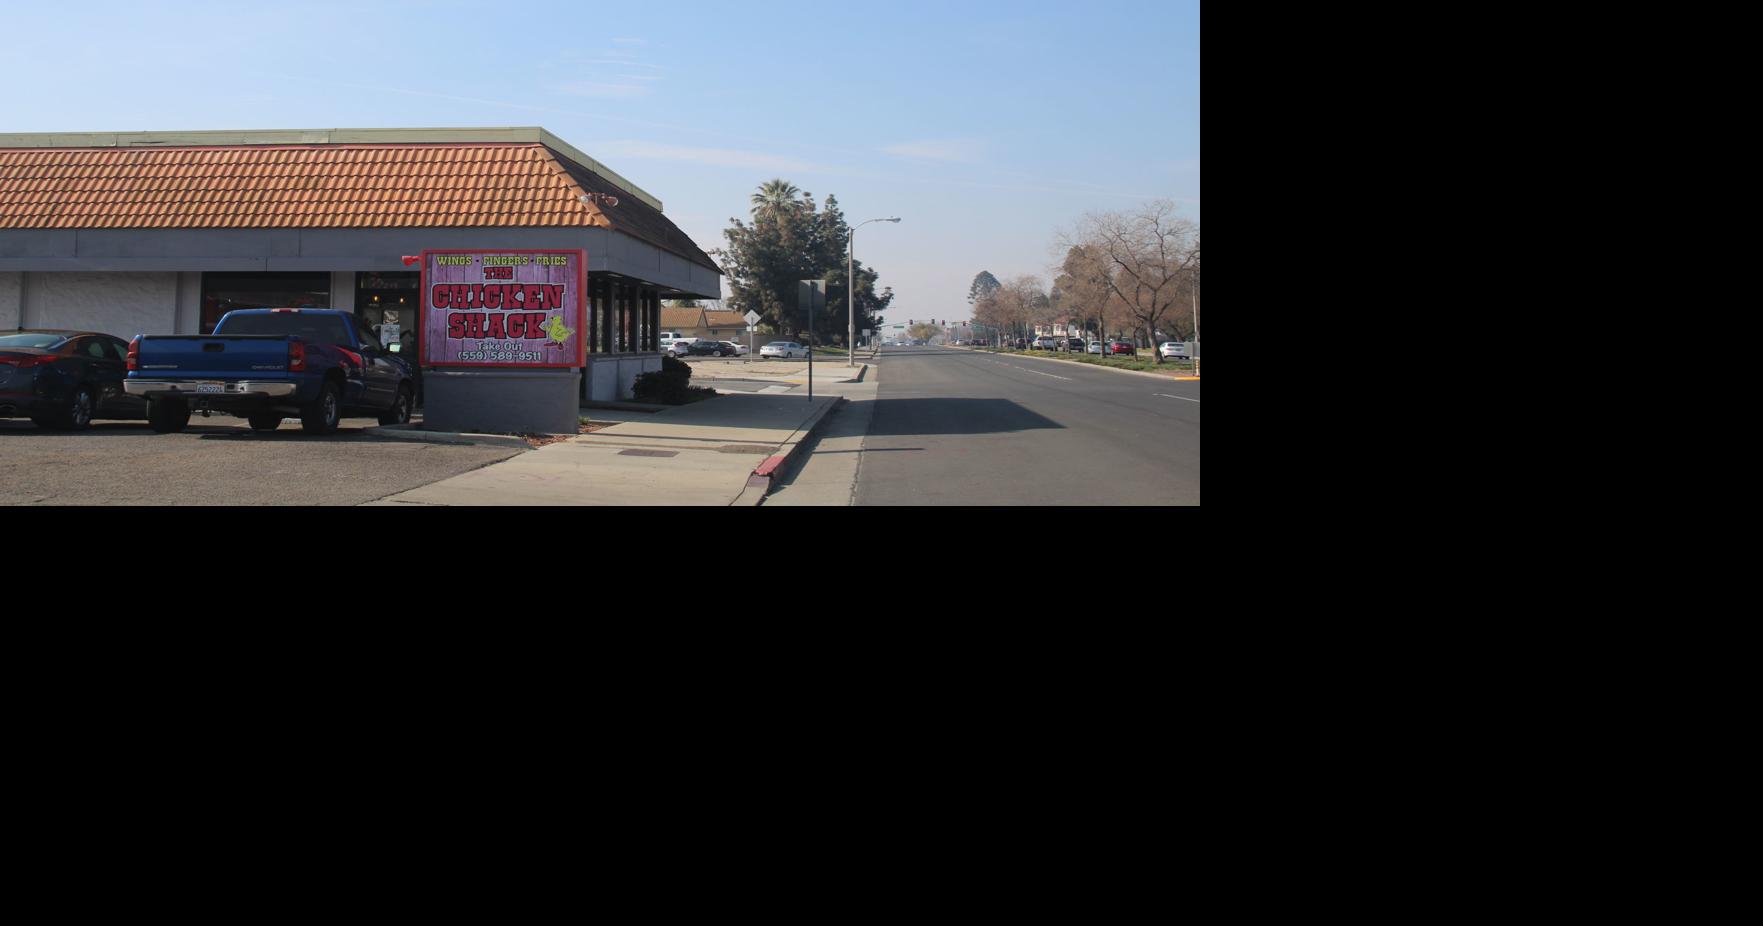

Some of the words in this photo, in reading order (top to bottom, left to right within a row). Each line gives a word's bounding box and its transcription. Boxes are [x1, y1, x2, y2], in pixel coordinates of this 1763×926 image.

[437, 255, 472, 265] WINGS
[483, 255, 529, 265] FINGERS
[536, 255, 567, 265] FRIES
[484, 267, 513, 280] THE
[432, 284, 564, 310] CHICKEN
[448, 312, 547, 339] SHACK
[477, 342, 501, 351] Take
[504, 342, 523, 351] Out
[457, 351, 488, 361] (559)
[490, 351, 541, 361] 589-9511
